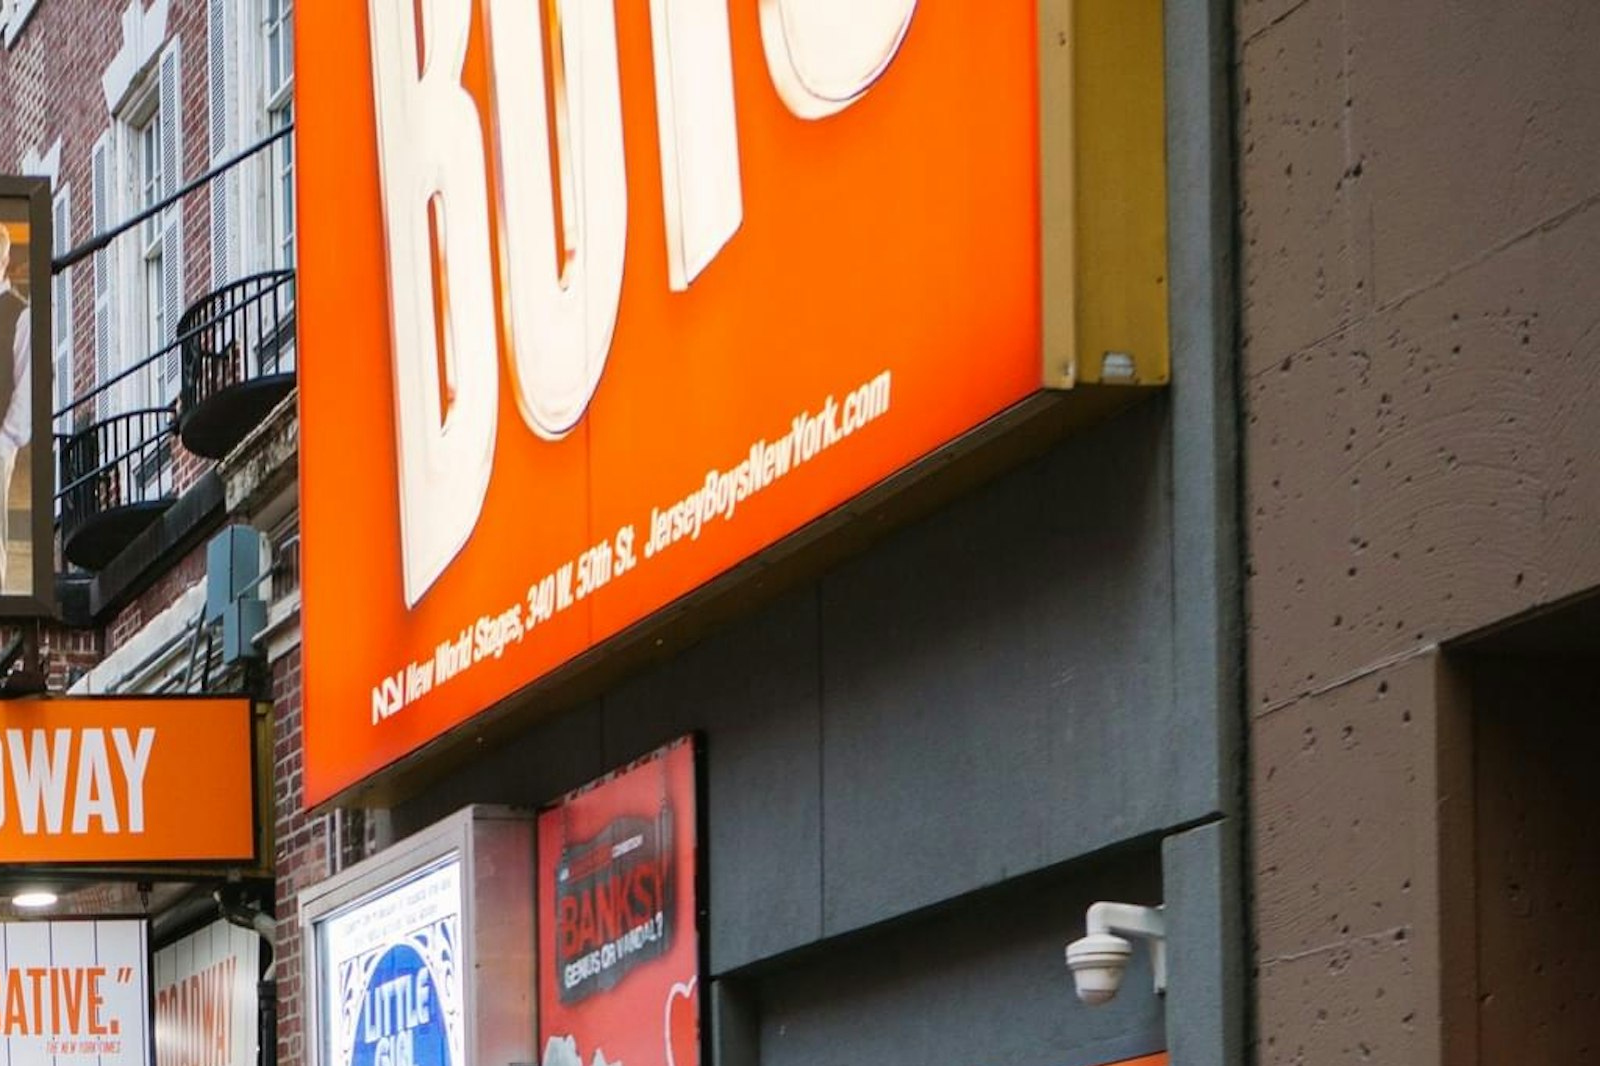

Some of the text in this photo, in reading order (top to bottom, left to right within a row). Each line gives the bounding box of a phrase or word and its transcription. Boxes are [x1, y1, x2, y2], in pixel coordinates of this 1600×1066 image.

[405, 657, 436, 706] New
[435, 624, 474, 687] World
[474, 602, 525, 664] Stages,
[525, 574, 556, 632] 340
[576, 528, 613, 600] 50th
[614, 524, 638, 578] St.
[644, 369, 891, 559] JerseyBoysNewYork.com
[363, 965, 431, 1045] LITTLE
